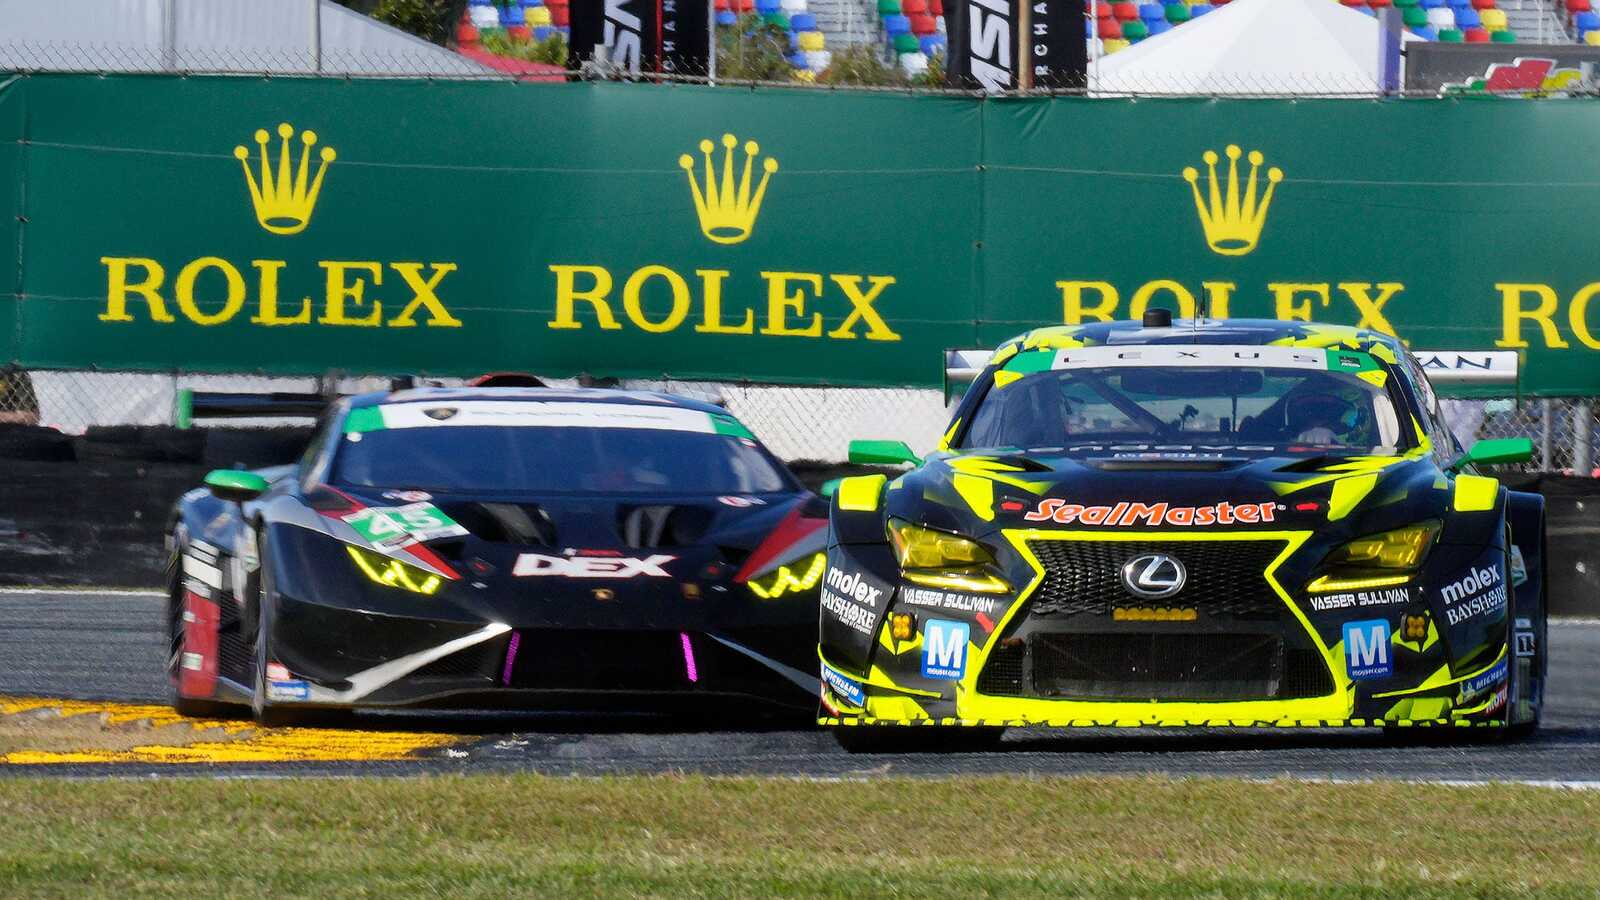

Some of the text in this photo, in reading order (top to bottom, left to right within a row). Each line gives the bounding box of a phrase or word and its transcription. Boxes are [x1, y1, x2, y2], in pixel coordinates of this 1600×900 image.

[1034, 2, 1049, 91] RCHA
[98, 256, 463, 328] ROLEX
[547, 264, 902, 341] ROLEX
[1063, 351, 1319, 363] LEXUS
[1416, 355, 1492, 370] AN
[368, 508, 444, 536] 45
[1024, 498, 1277, 526] SealMaster
[512, 553, 681, 579] DEX
[1440, 565, 1500, 605] molex
[827, 566, 880, 608] molex
[904, 588, 995, 613] VASSER SULLIVAN
[1310, 588, 1410, 611] VASSER SULLIVAN
[821, 588, 876, 630] BAYSHORE
[927, 626, 963, 668] M
[1349, 625, 1387, 667] M
